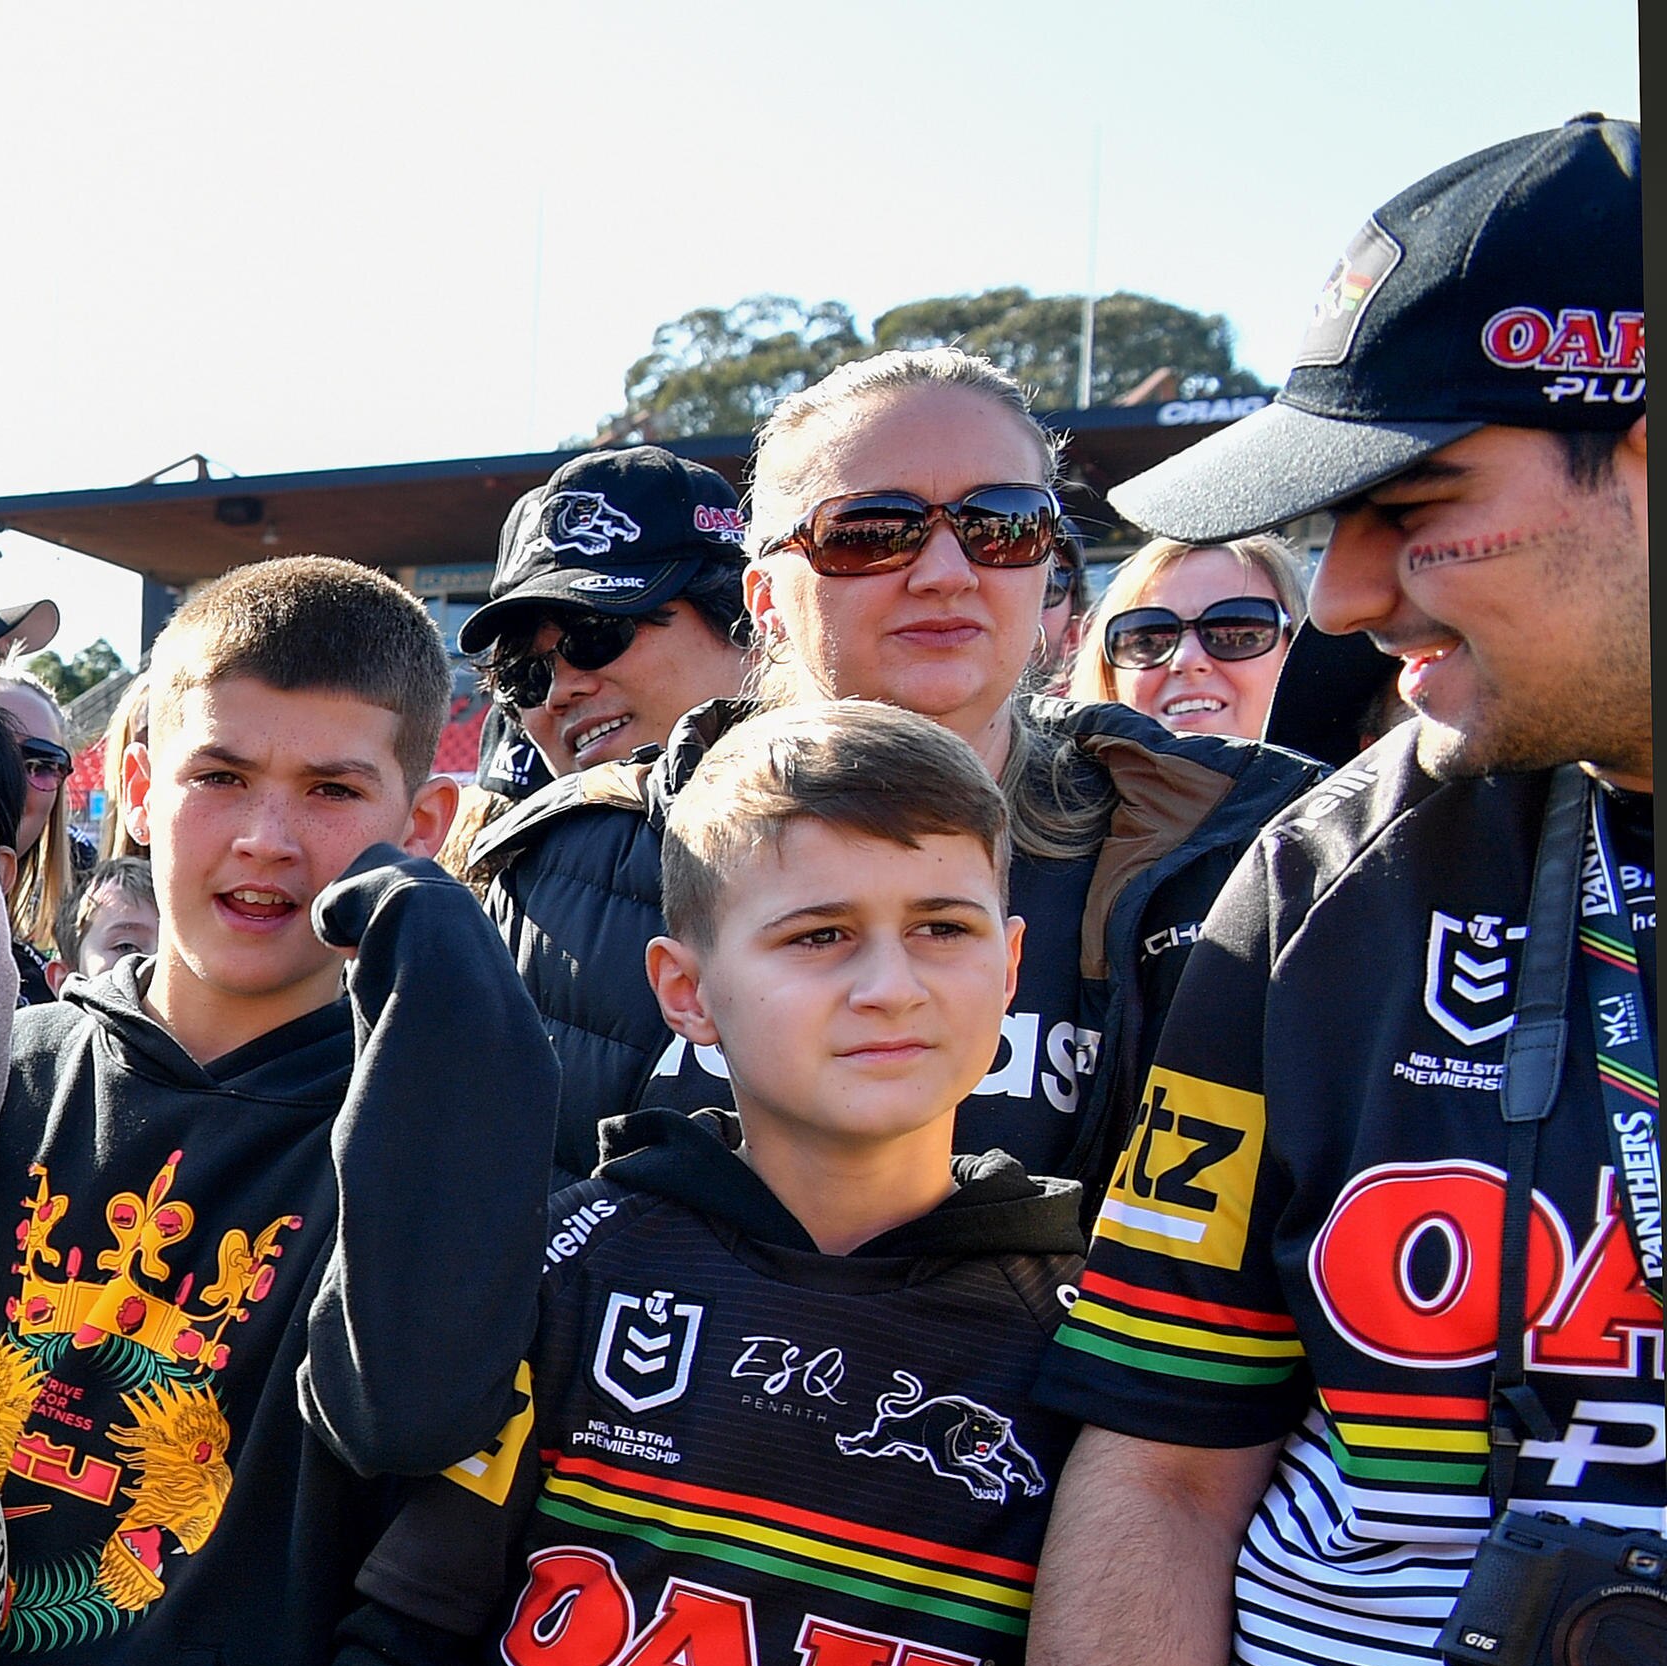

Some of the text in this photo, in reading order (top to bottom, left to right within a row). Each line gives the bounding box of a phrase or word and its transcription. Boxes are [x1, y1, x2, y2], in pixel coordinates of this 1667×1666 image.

[1543, 377, 1646, 403] PLU
[1393, 1062, 1503, 1091] PREMIERS
[1409, 1051, 1506, 1076] NRL TELST
[1613, 1111, 1663, 1280] PANTHERS
[1308, 1158, 1664, 1379] OA
[730, 1336, 849, 1406] ESQ
[38, 1389, 69, 1409] FOR
[44, 1376, 85, 1401] RIVE
[31, 1399, 95, 1432] EATNESS
[740, 1395, 829, 1425] PENRITH
[572, 1432, 682, 1466] PREMIERSHIP
[588, 1420, 674, 1449] NRL TELSTRA
[1600, 1584, 1633, 1598] CANON
[1633, 1584, 1661, 1598] ZOOM
[1464, 1632, 1498, 1651] G16
